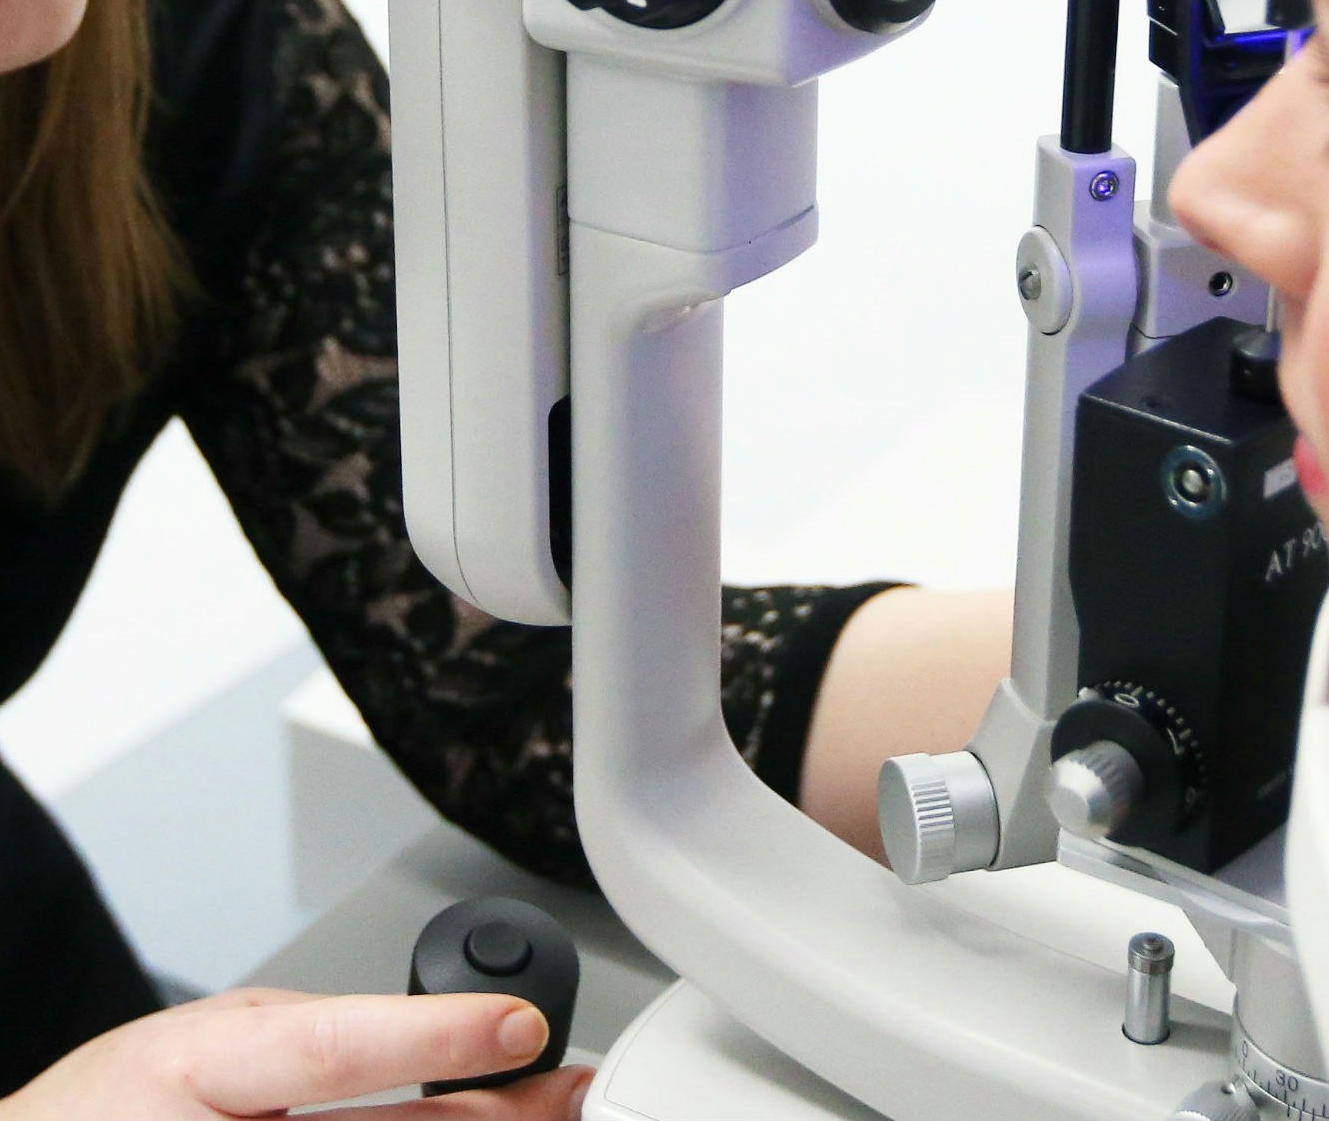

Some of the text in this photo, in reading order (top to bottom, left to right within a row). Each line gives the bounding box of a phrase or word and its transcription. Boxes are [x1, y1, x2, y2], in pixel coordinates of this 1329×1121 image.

[1265, 520, 1327, 582] AT 90
[1275, 1069, 1298, 1092] 30
